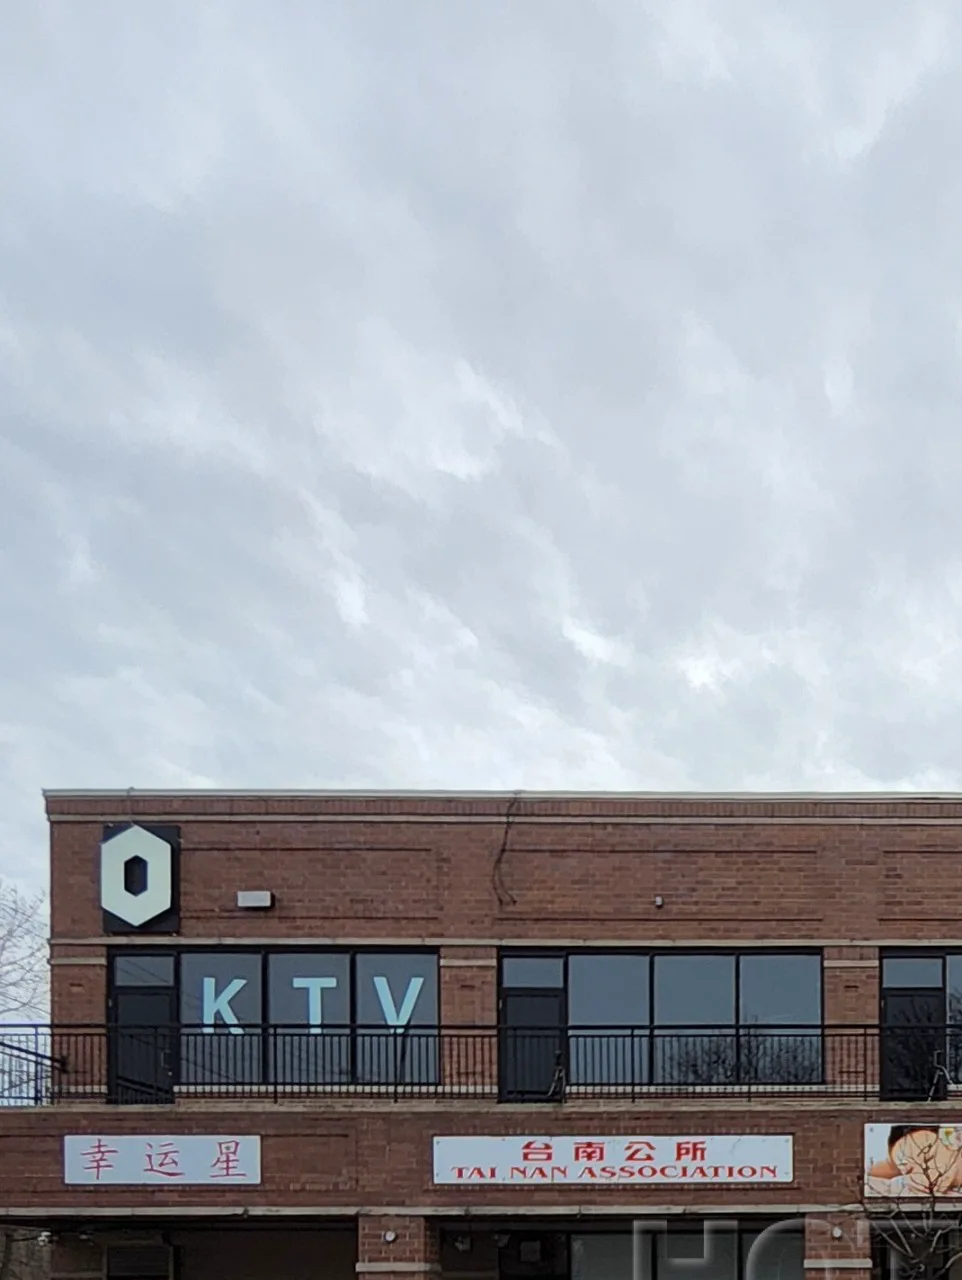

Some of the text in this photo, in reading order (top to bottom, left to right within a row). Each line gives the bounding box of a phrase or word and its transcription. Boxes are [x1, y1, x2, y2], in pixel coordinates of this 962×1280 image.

[80, 1138, 247, 1180] 幸运星
[521, 1140, 708, 1162] 台南公所
[451, 1165, 778, 1179] TAI NAN ASSOCIATION
